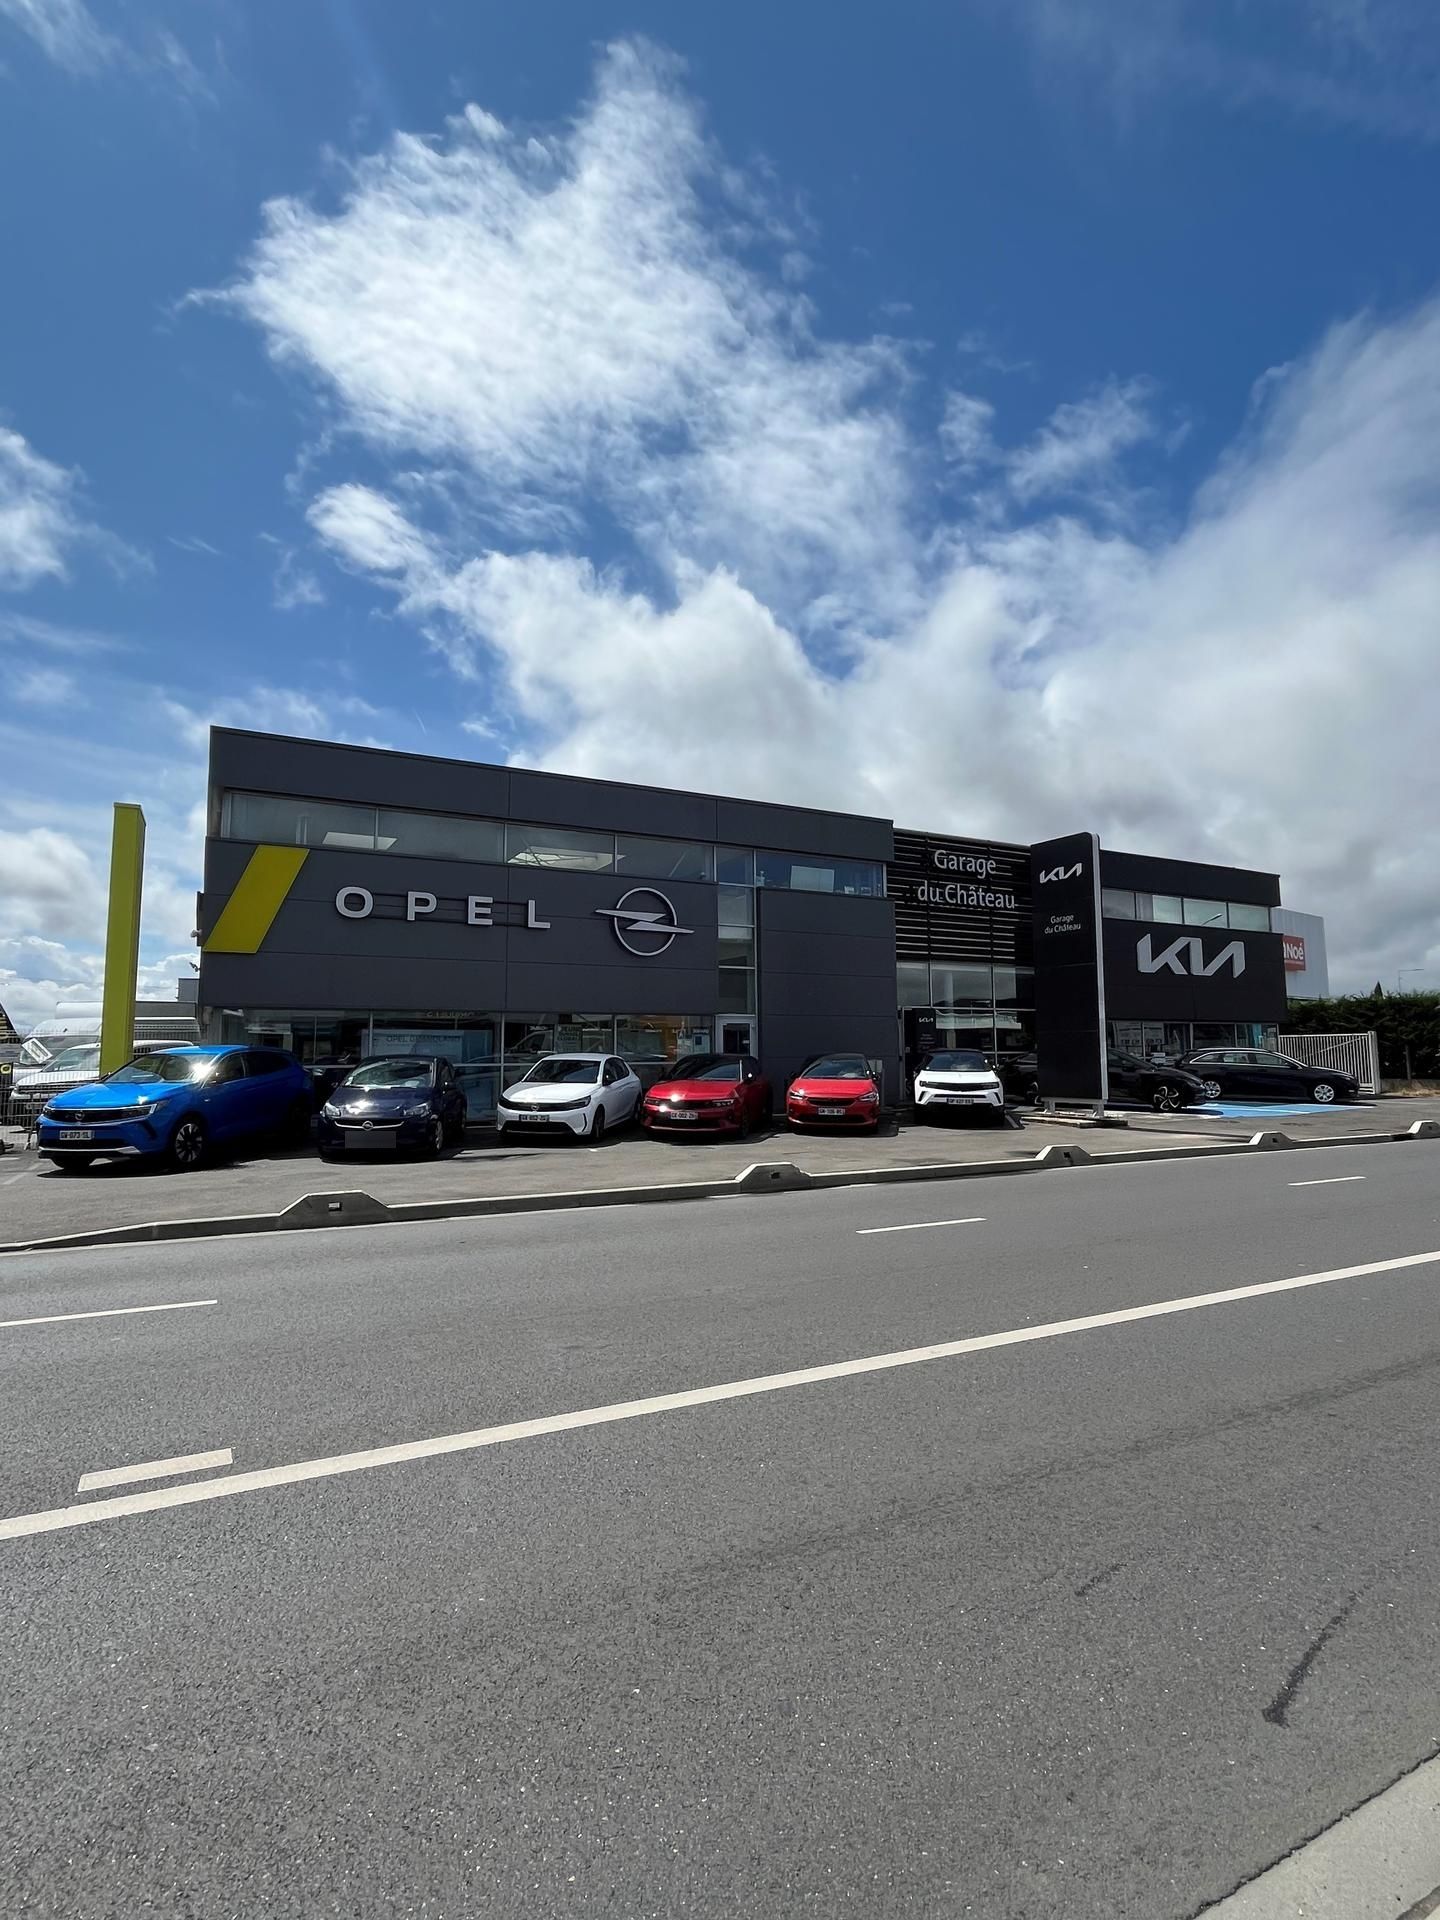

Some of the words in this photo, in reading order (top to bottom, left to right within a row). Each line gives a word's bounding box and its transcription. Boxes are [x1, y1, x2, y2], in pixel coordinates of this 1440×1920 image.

[934, 850, 997, 879] Garage
[1039, 862, 1083, 884] KIA
[335, 886, 551, 929] OPEL
[917, 880, 939, 901] du
[944, 883, 1015, 909] Château
[1044, 926, 1053, 935] du
[1053, 922, 1082, 934] Château
[1050, 913, 1075, 925] Garage
[1136, 933, 1246, 979] KIA
